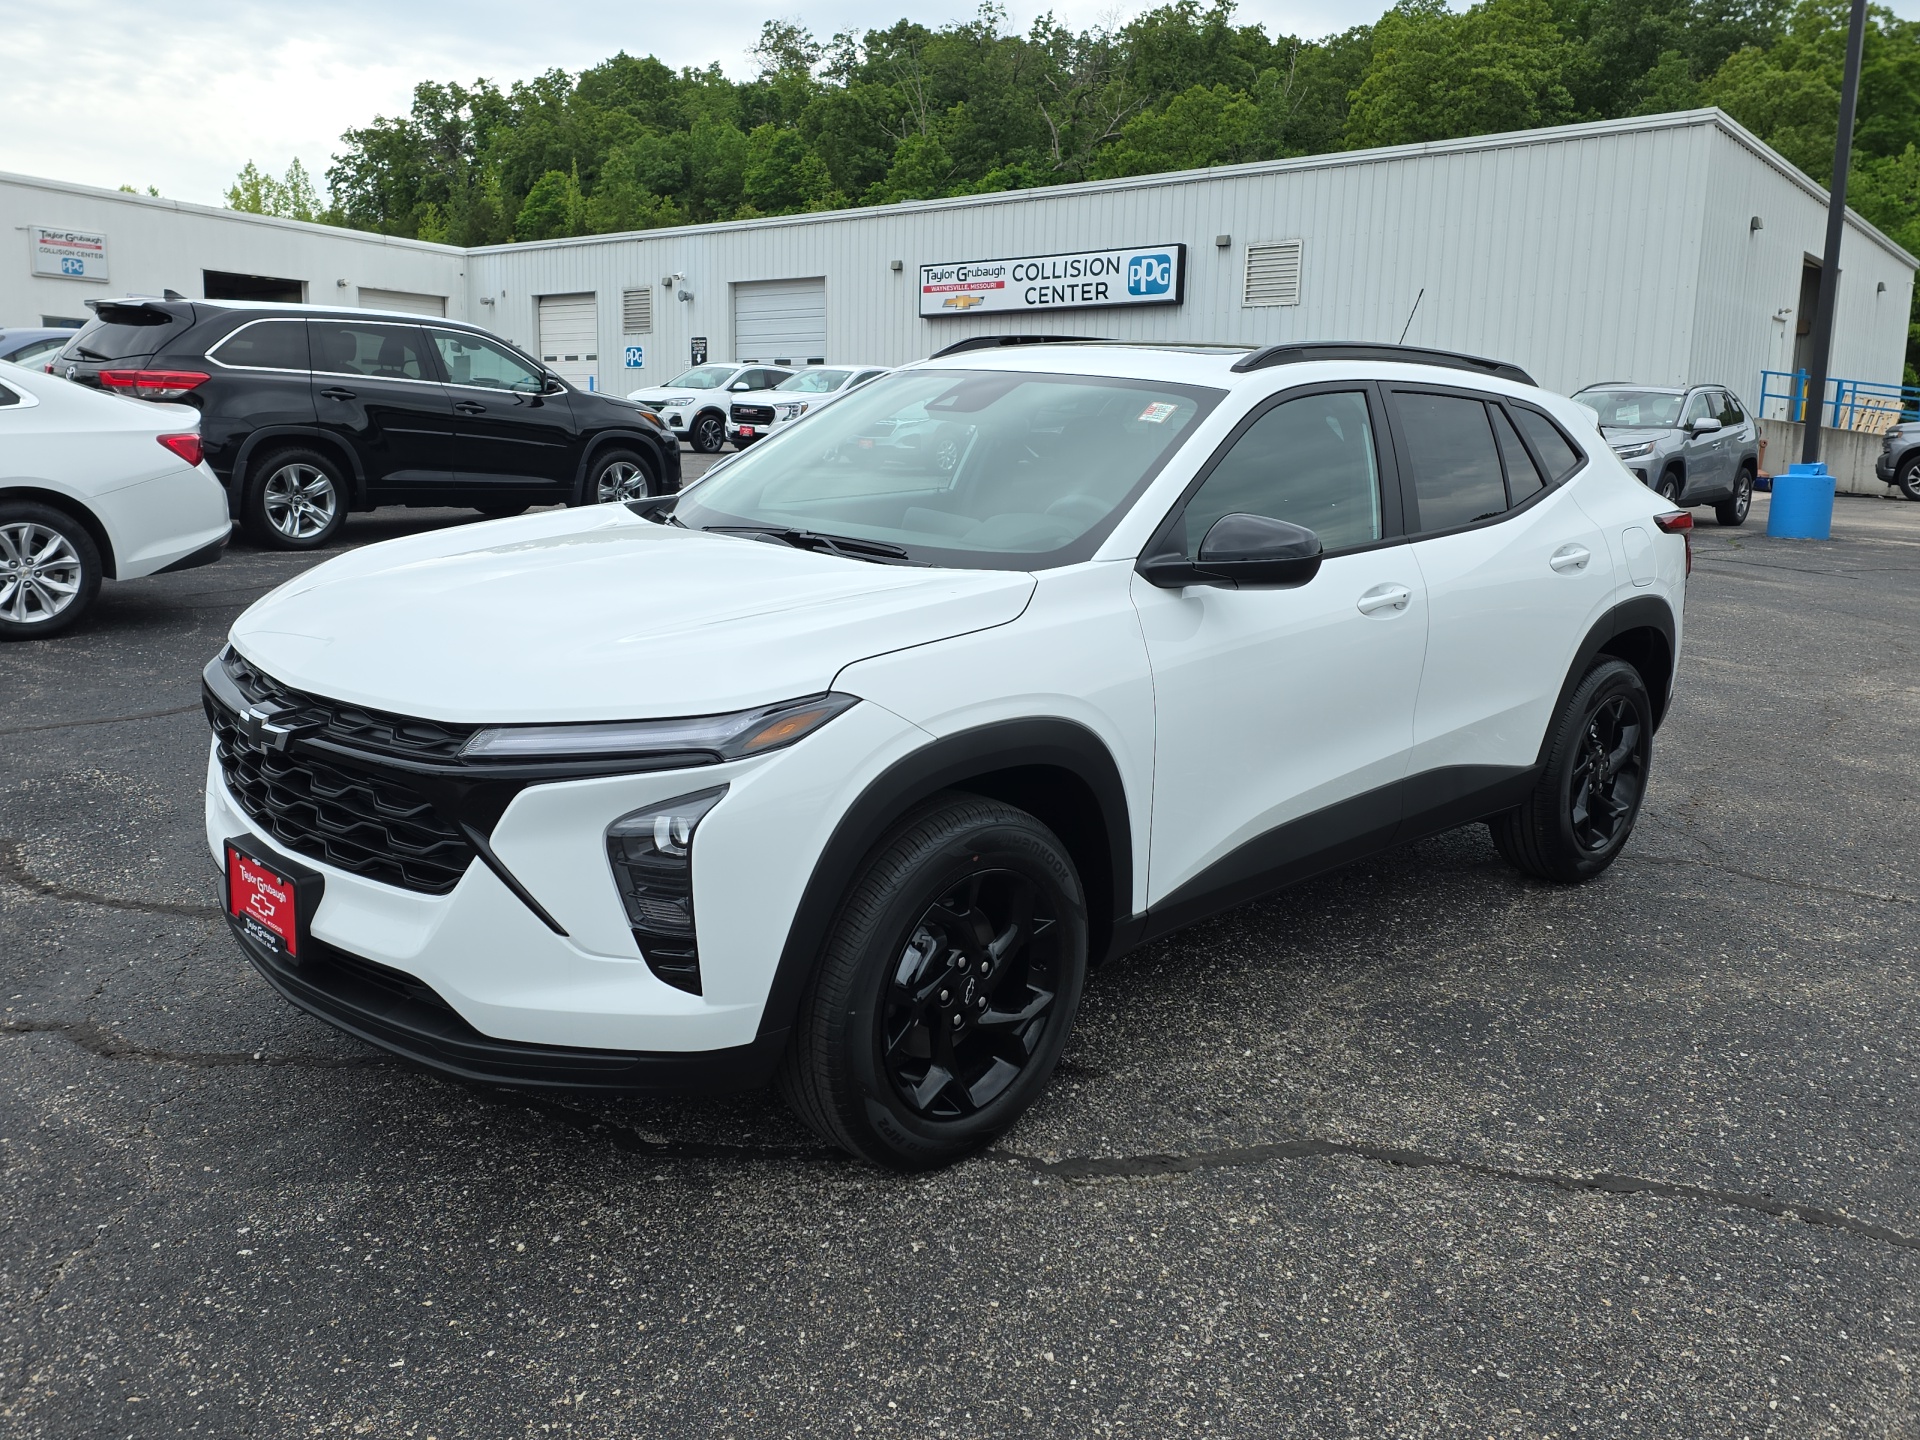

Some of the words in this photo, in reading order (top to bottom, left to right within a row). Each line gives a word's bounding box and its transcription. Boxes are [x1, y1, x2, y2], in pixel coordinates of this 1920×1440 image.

[38, 229, 64, 240] Taylor
[65, 233, 102, 244] Grubaugh
[39, 247, 75, 256] COLLISION
[76, 251, 104, 259] CENTER
[62, 259, 83, 274] PPG
[923, 268, 955, 284] Taylor
[956, 265, 1006, 281] Grubaugh
[1012, 256, 1121, 282] COLLISION
[1129, 258, 1170, 293] PPG
[931, 284, 970, 292] WAYNESVILLE,
[970, 282, 997, 290] MISSOURI
[1024, 281, 1109, 305] CENTER
[626, 348, 643, 366] PPG
[239, 864, 257, 885] Taylor
[256, 877, 287, 903] Grubaugh
